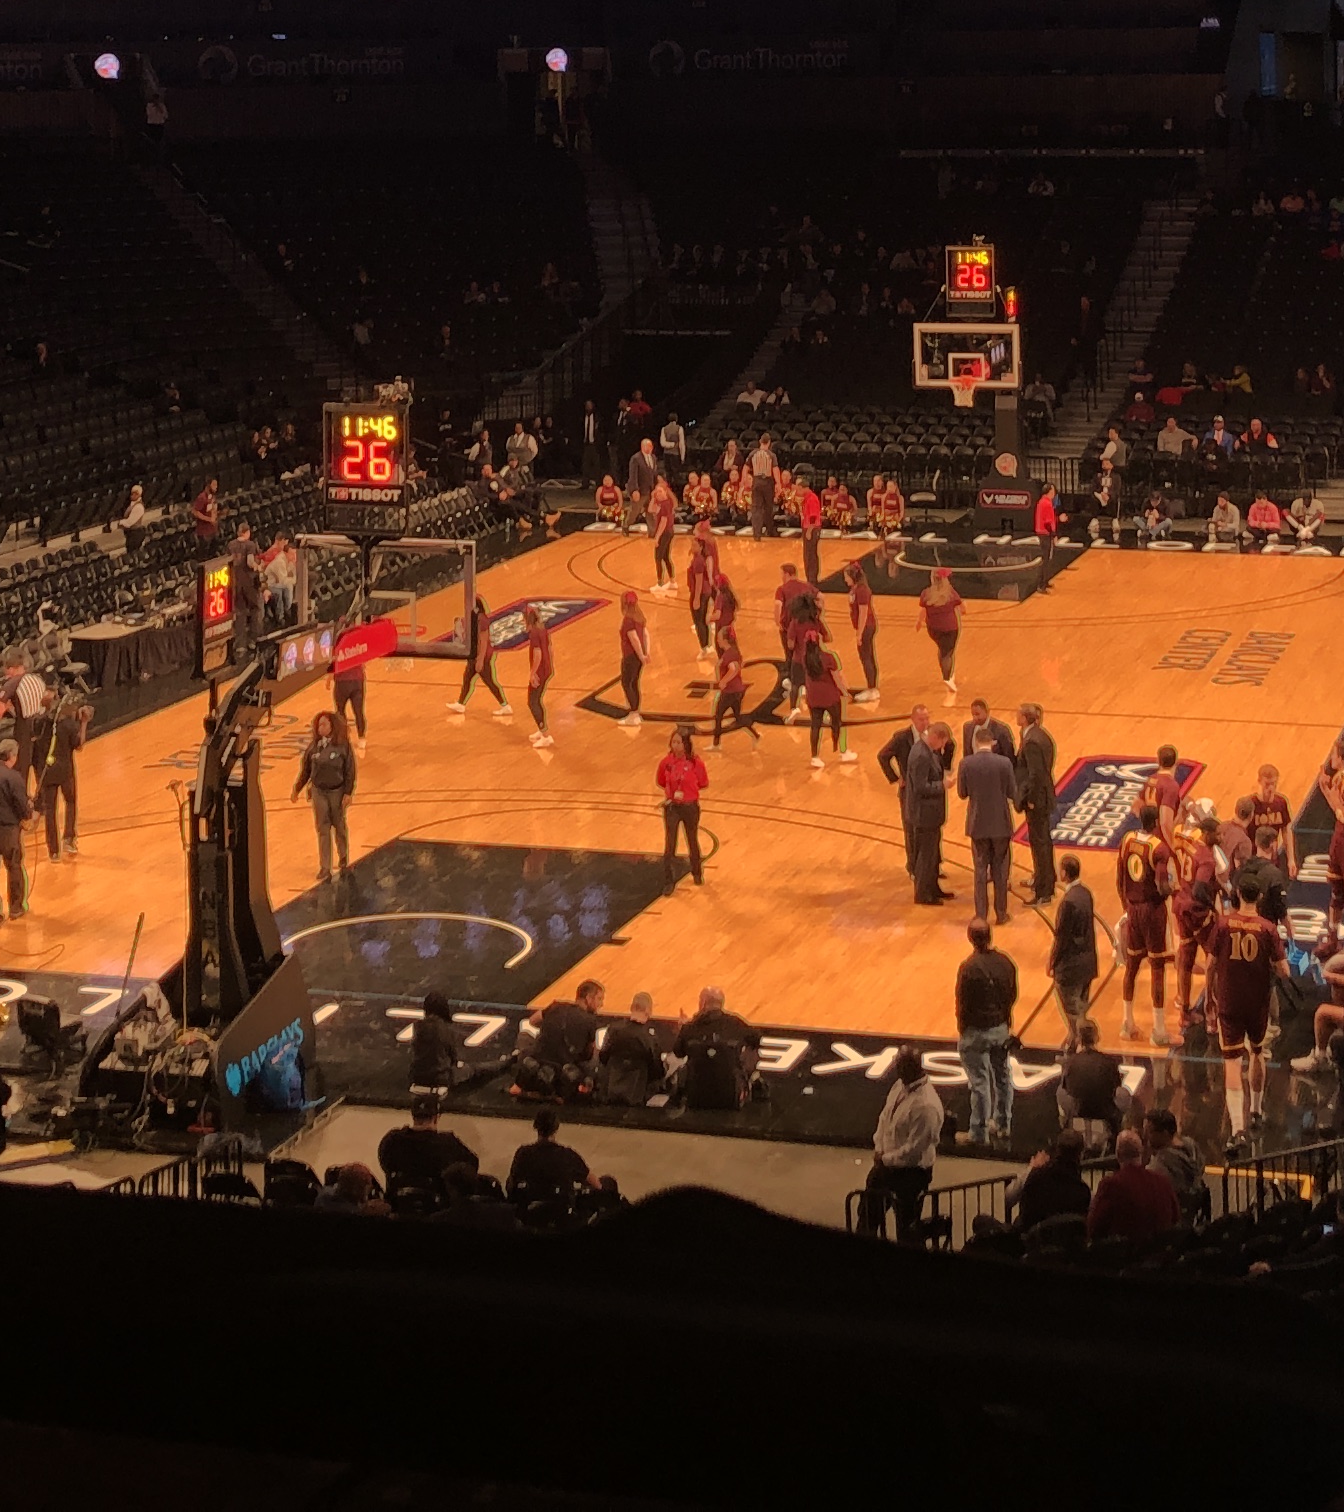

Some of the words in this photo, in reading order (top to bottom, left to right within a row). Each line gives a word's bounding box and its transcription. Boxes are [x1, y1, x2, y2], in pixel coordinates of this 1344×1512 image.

[957, 251, 989, 265] 11:46
[957, 265, 986, 288] 26
[341, 415, 397, 441] 11:46
[342, 440, 392, 481] 26
[348, 488, 402, 502] TISSOT
[209, 588, 226, 617] 26
[1049, 781, 1117, 841] RESERVE
[1229, 932, 1259, 962] 10
